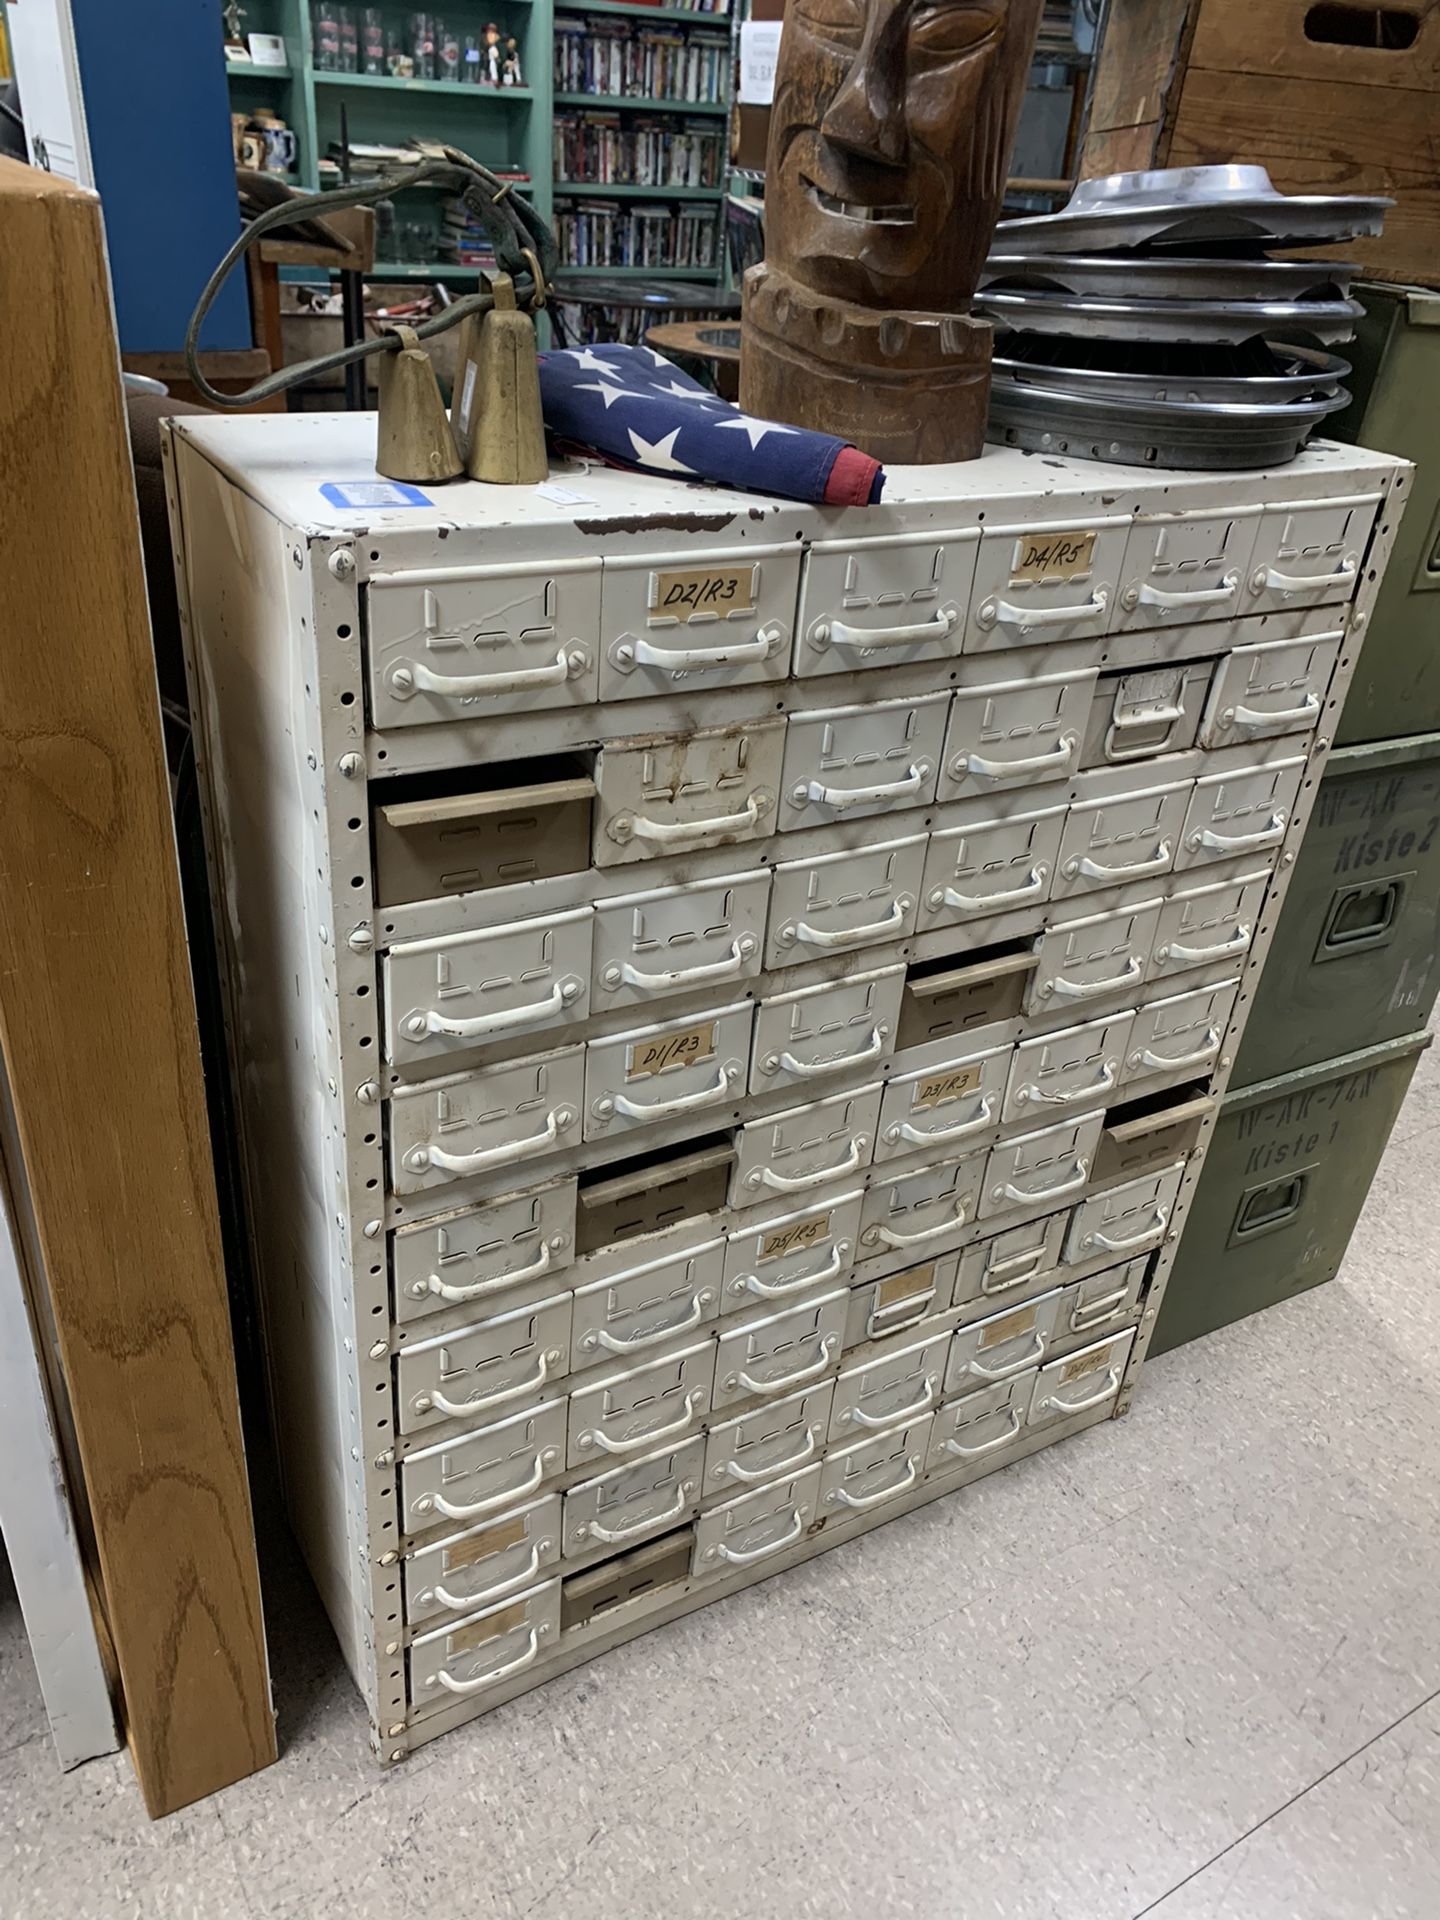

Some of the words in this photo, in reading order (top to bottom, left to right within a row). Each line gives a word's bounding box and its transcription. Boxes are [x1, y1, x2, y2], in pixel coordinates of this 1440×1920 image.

[1022, 539, 1084, 571] D4/R5
[663, 578, 738, 609] D2/R3
[1333, 828, 1417, 874] Kiste
[642, 1036, 700, 1067] D1/R3
[920, 1074, 970, 1100] D3/R3
[1244, 1132, 1320, 1175] Kiste
[1328, 1121, 1340, 1144] 1
[765, 1220, 826, 1253] D5/R5
